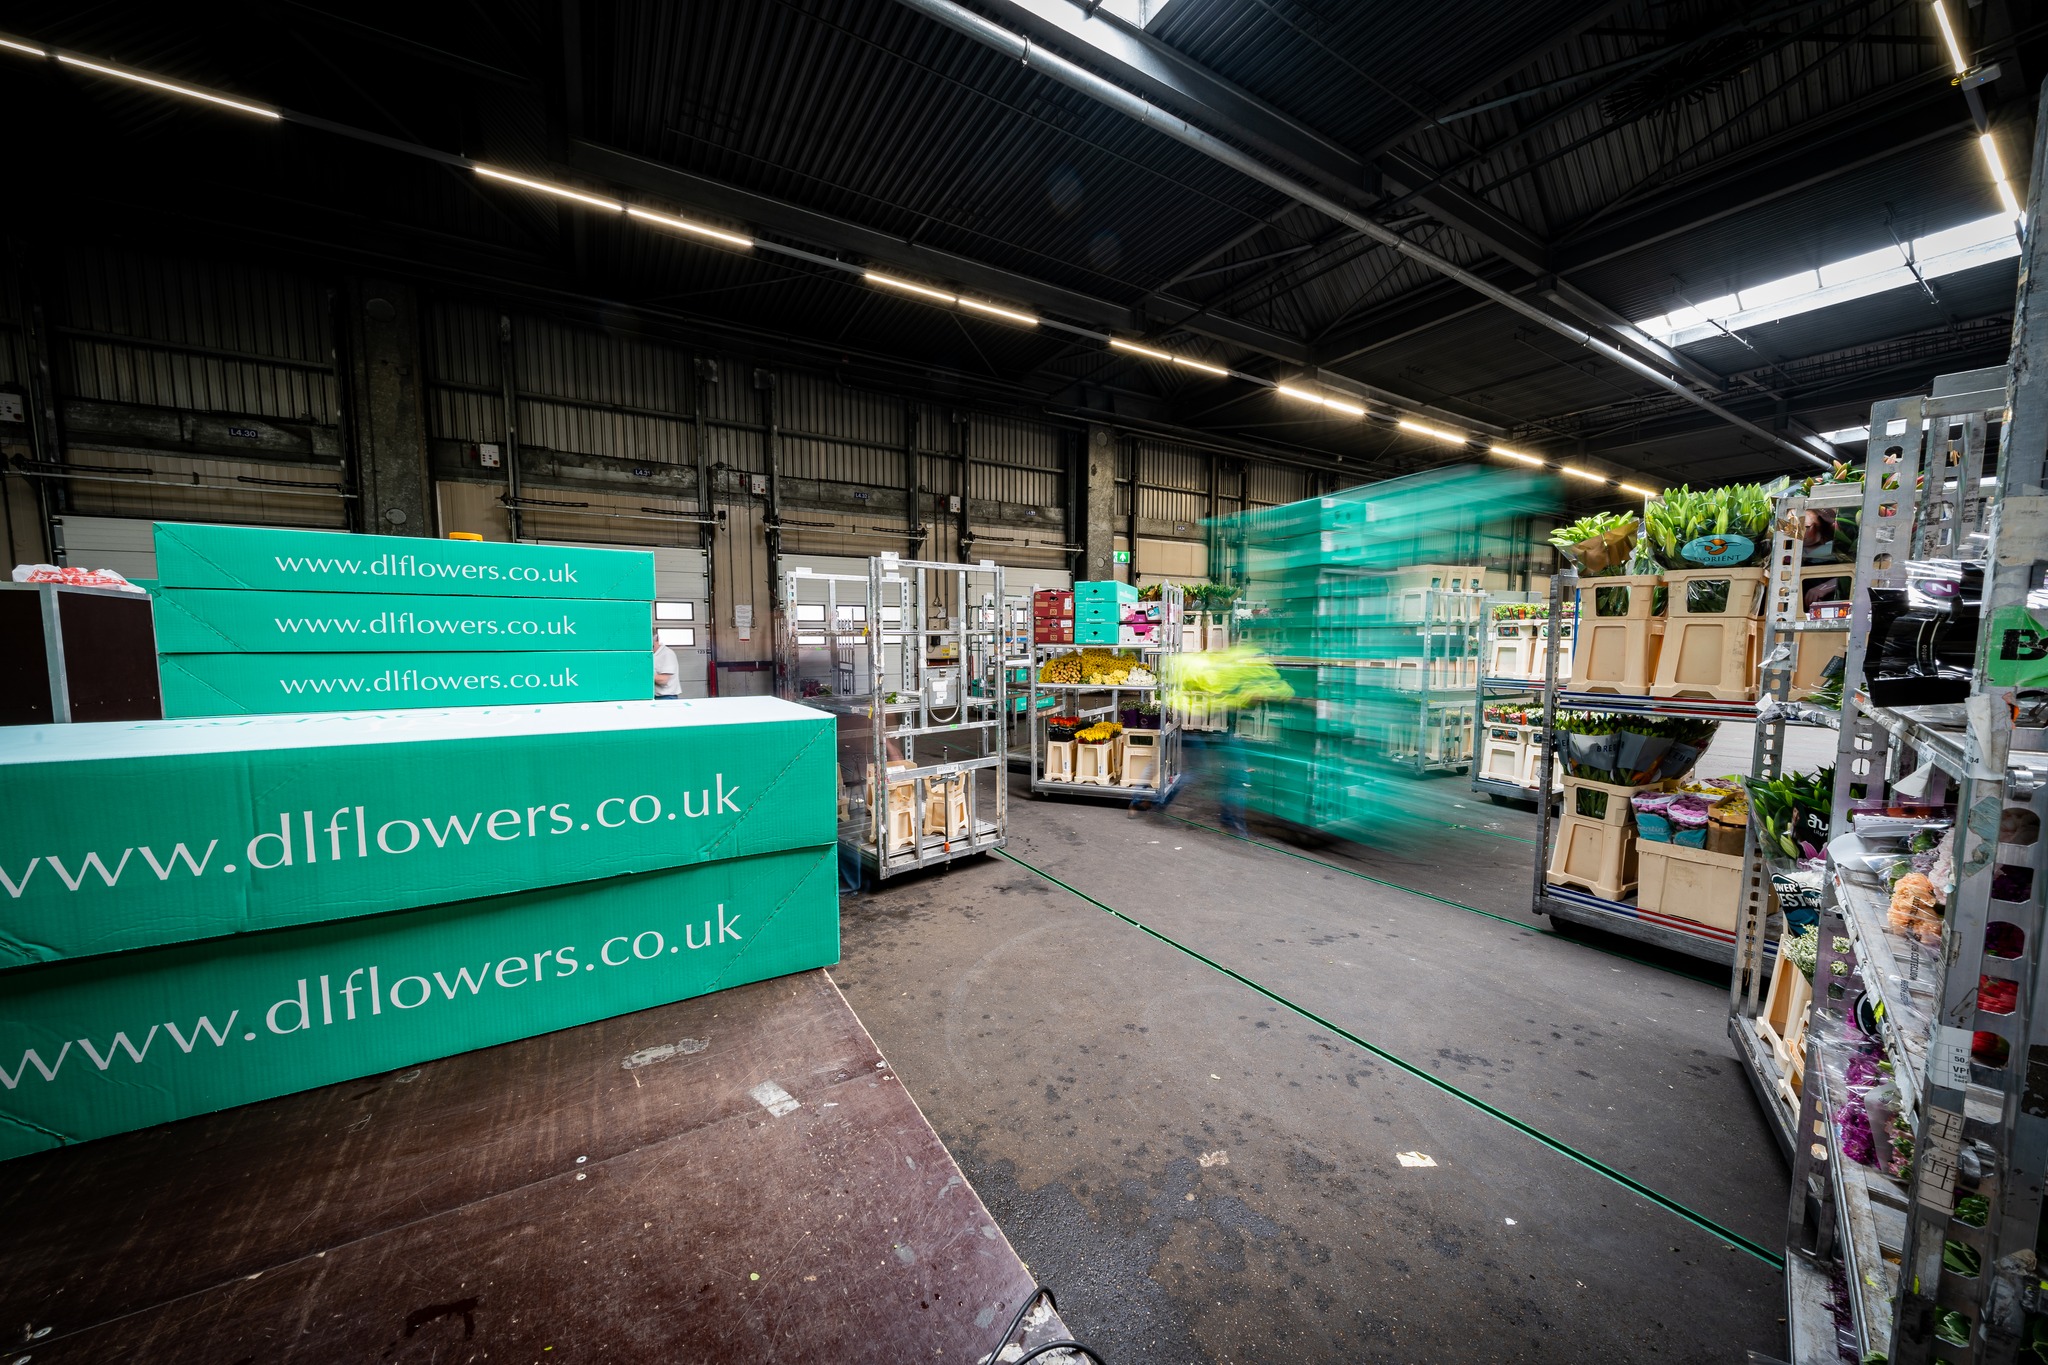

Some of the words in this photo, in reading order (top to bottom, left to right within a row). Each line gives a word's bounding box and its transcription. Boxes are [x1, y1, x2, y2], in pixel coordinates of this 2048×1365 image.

[231, 428, 256, 438] L4.30
[275, 554, 578, 583] www.dlflowers.co.uk
[275, 612, 577, 635] www.dlflowers.co.uk
[280, 667, 579, 694] www.dlflowers.co.uk
